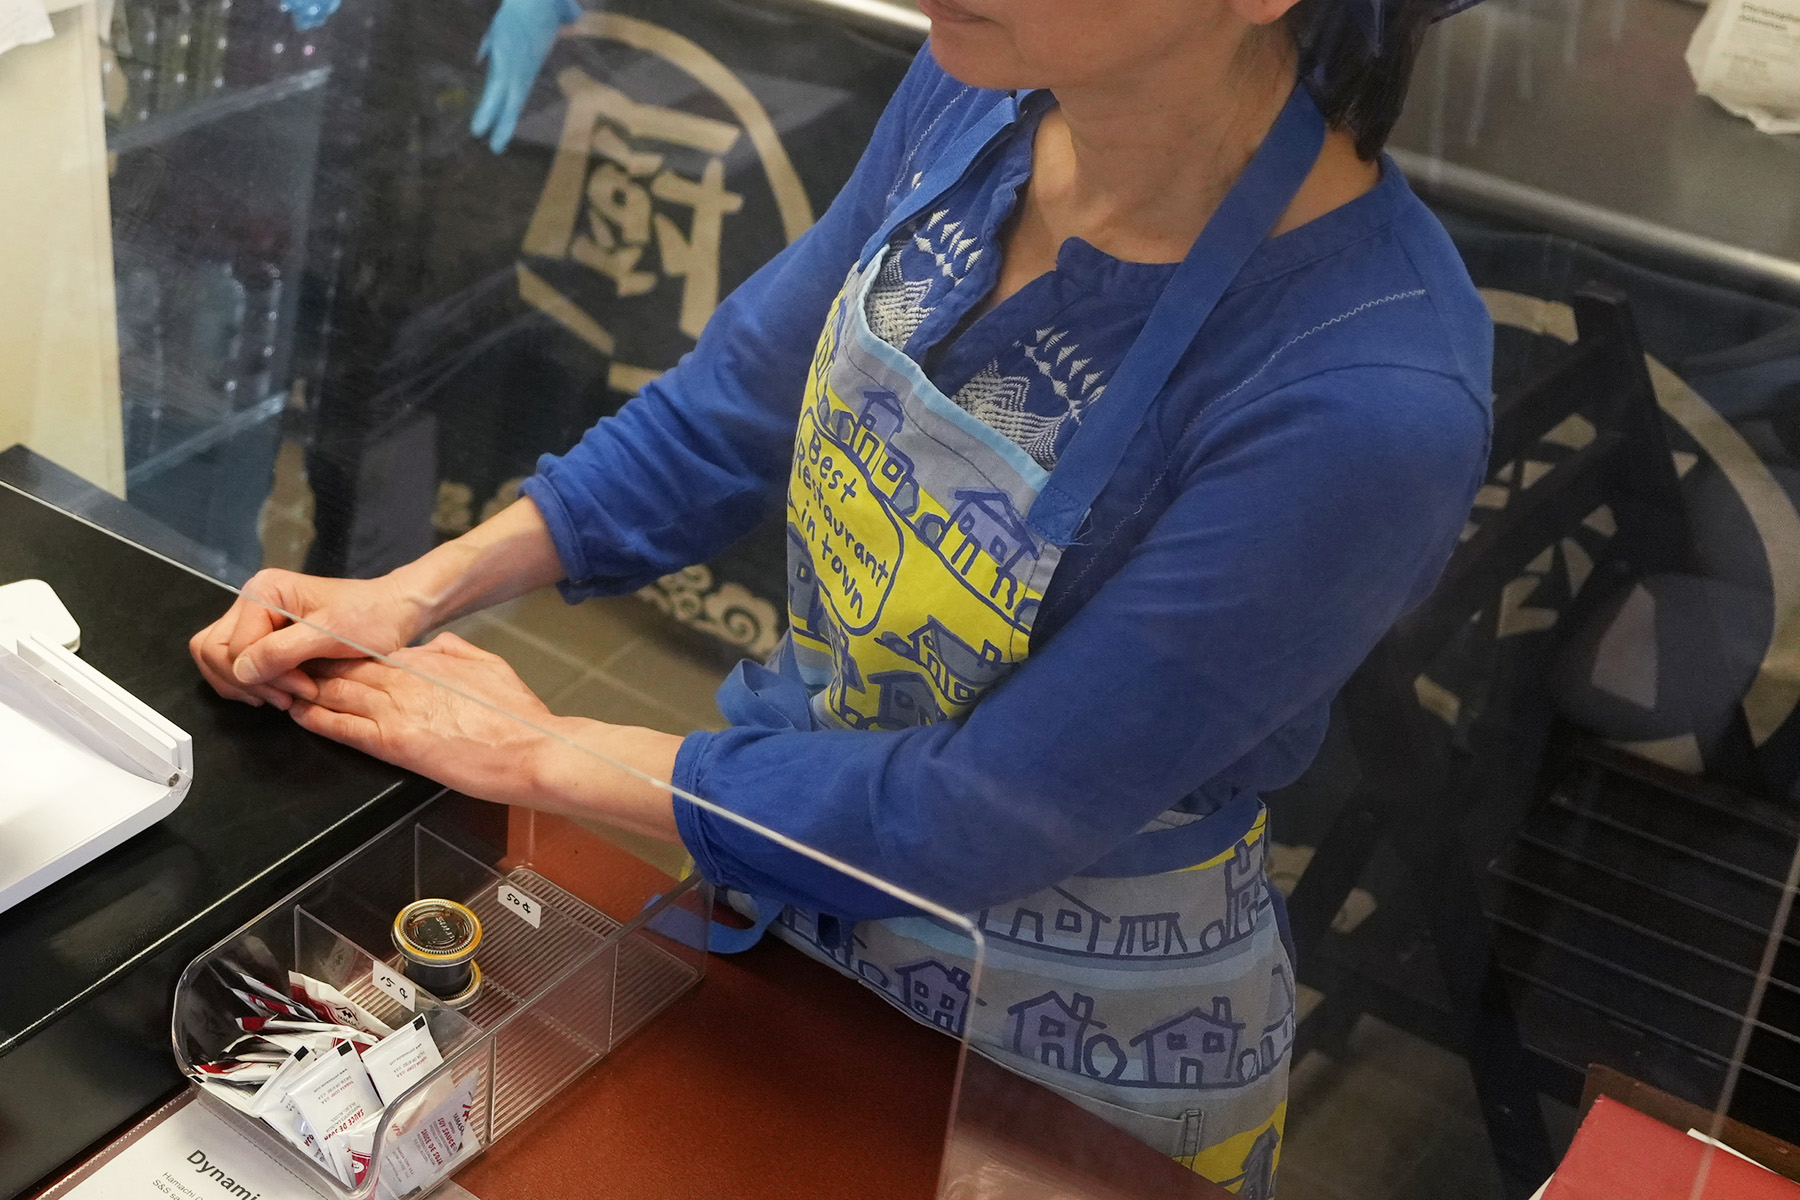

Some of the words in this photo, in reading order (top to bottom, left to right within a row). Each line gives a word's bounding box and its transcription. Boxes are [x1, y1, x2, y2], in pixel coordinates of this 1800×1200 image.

[807, 430, 858, 503] Best
[795, 443, 890, 589] Restaurant
[800, 501, 817, 542] in
[821, 538, 864, 620] town
[442, 1128, 456, 1148] SAUCE
[152, 1179, 172, 1195] S&S
[162, 1171, 196, 1198] Hamachi
